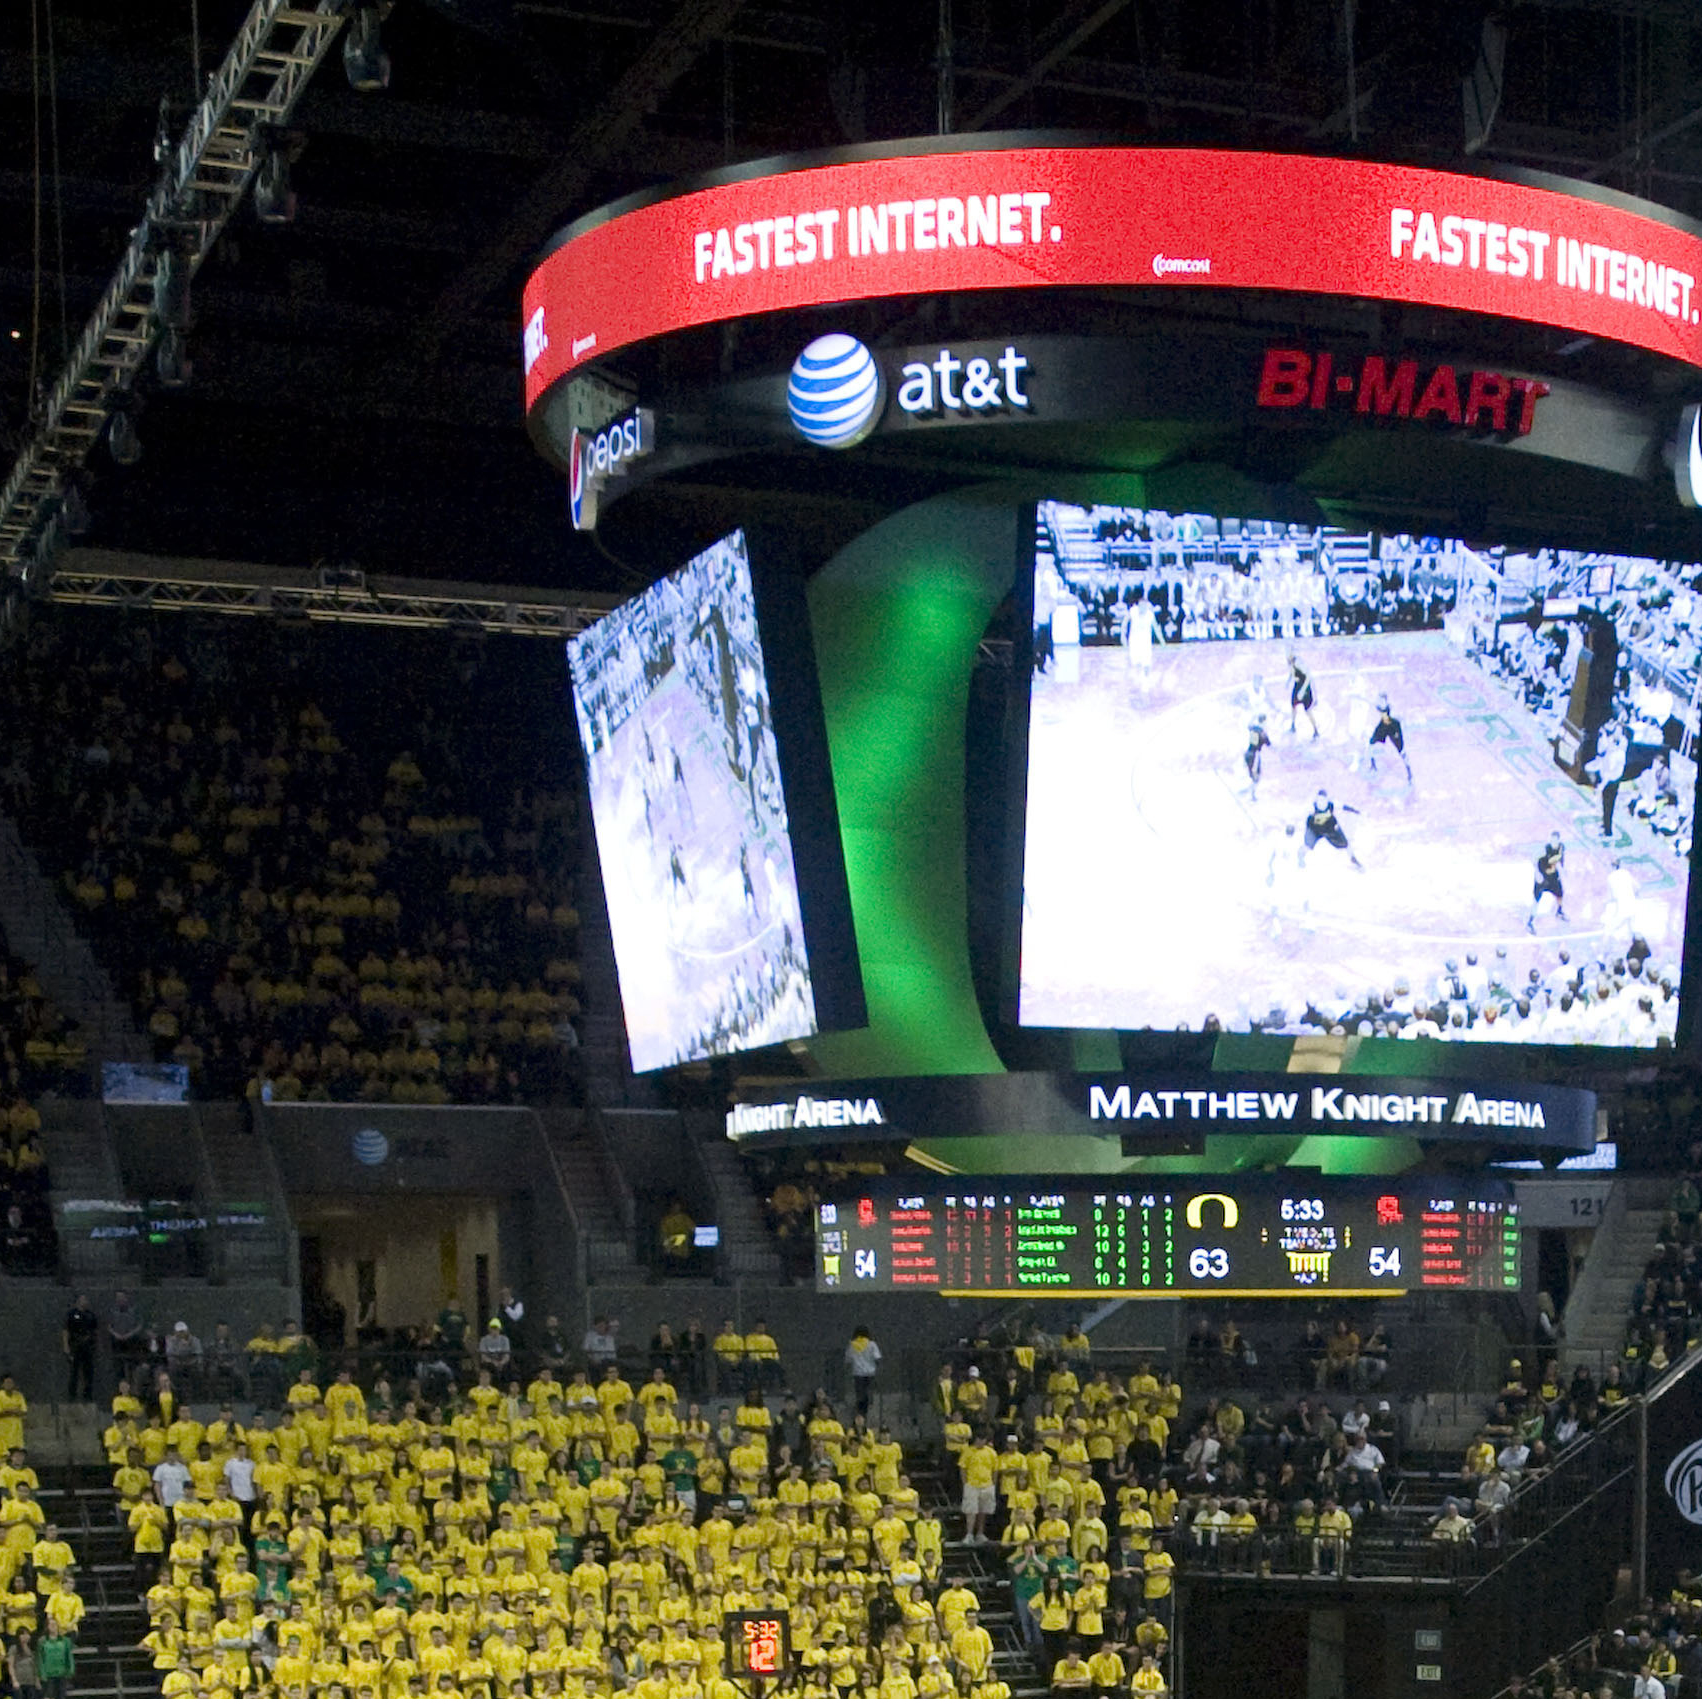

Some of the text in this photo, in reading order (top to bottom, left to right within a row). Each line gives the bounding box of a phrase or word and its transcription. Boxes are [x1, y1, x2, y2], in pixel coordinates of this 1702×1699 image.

[694, 191, 1062, 284] FASTEST INTERNET.
[1152, 252, 1211, 278] comcast
[1390, 207, 1701, 326] FASTEST INTERNET.
[899, 346, 1029, 413] at&t
[586, 406, 642, 478] pepsi
[793, 1095, 885, 1129] ARENA
[1088, 1085, 1547, 1129] MATTHEW KNIGHT ARENA
[1165, 1207, 1174, 1221] 2
[1280, 1198, 1325, 1221] 5:33
[1165, 1239, 1174, 1254] 2
[854, 1249, 877, 1280] 54
[1189, 1248, 1231, 1280] 63
[1368, 1247, 1402, 1277] 54
[1165, 1271, 1174, 1286] 2
[743, 1619, 779, 1640] 5:32
[747, 1639, 777, 1673] 12
